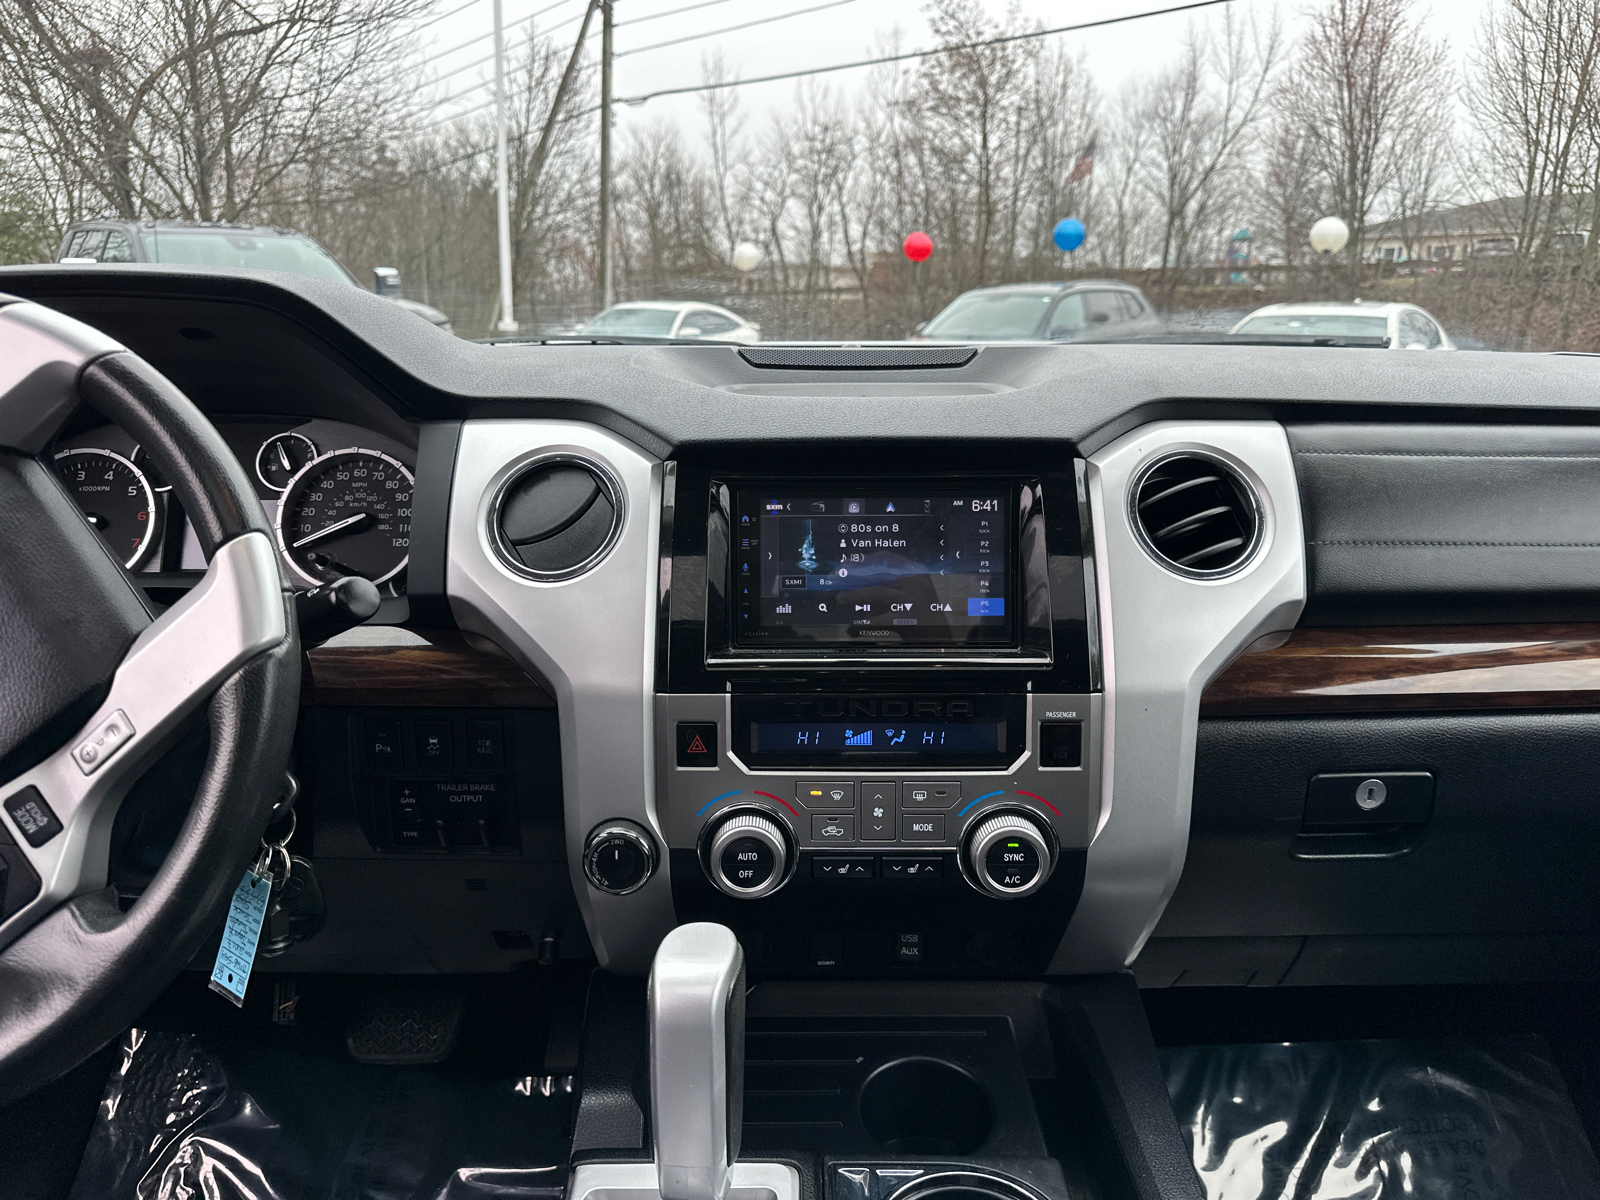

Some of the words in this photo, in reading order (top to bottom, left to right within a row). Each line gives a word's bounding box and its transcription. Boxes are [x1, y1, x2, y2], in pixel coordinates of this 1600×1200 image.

[77, 471, 86, 480] 3
[104, 471, 114, 480] 4
[337, 472, 350, 480] 50
[354, 469, 367, 477] 60
[372, 472, 385, 480] 70
[321, 480, 334, 489] 40
[385, 480, 399, 489] 80
[128, 486, 137, 496] 5
[310, 493, 323, 501] 30
[395, 493, 409, 501] 90
[972, 500, 998, 512] 6:41
[137, 511, 147, 521] 6
[302, 508, 316, 516] 20
[300, 524, 312, 532] 10
[850, 524, 872, 533] 80s
[892, 524, 900, 533] 8
[131, 538, 141, 548] 7
[392, 538, 410, 547] 120
[851, 539, 872, 548] Van
[875, 538, 907, 548] Halen
[890, 603, 903, 612] CH
[930, 603, 943, 612] CH
[784, 700, 974, 717] TUNDRA
[478, 739, 491, 747] TOW
[450, 795, 484, 803] OUTPUT
[13, 806, 39, 834] MODE
[913, 823, 934, 832] MODE
[738, 852, 758, 861] AUTO
[1003, 853, 1025, 862] SYNC
[738, 870, 754, 879] OFF
[1004, 875, 1021, 884] A/C
[901, 934, 919, 943] USB
[900, 946, 919, 955] AUX
